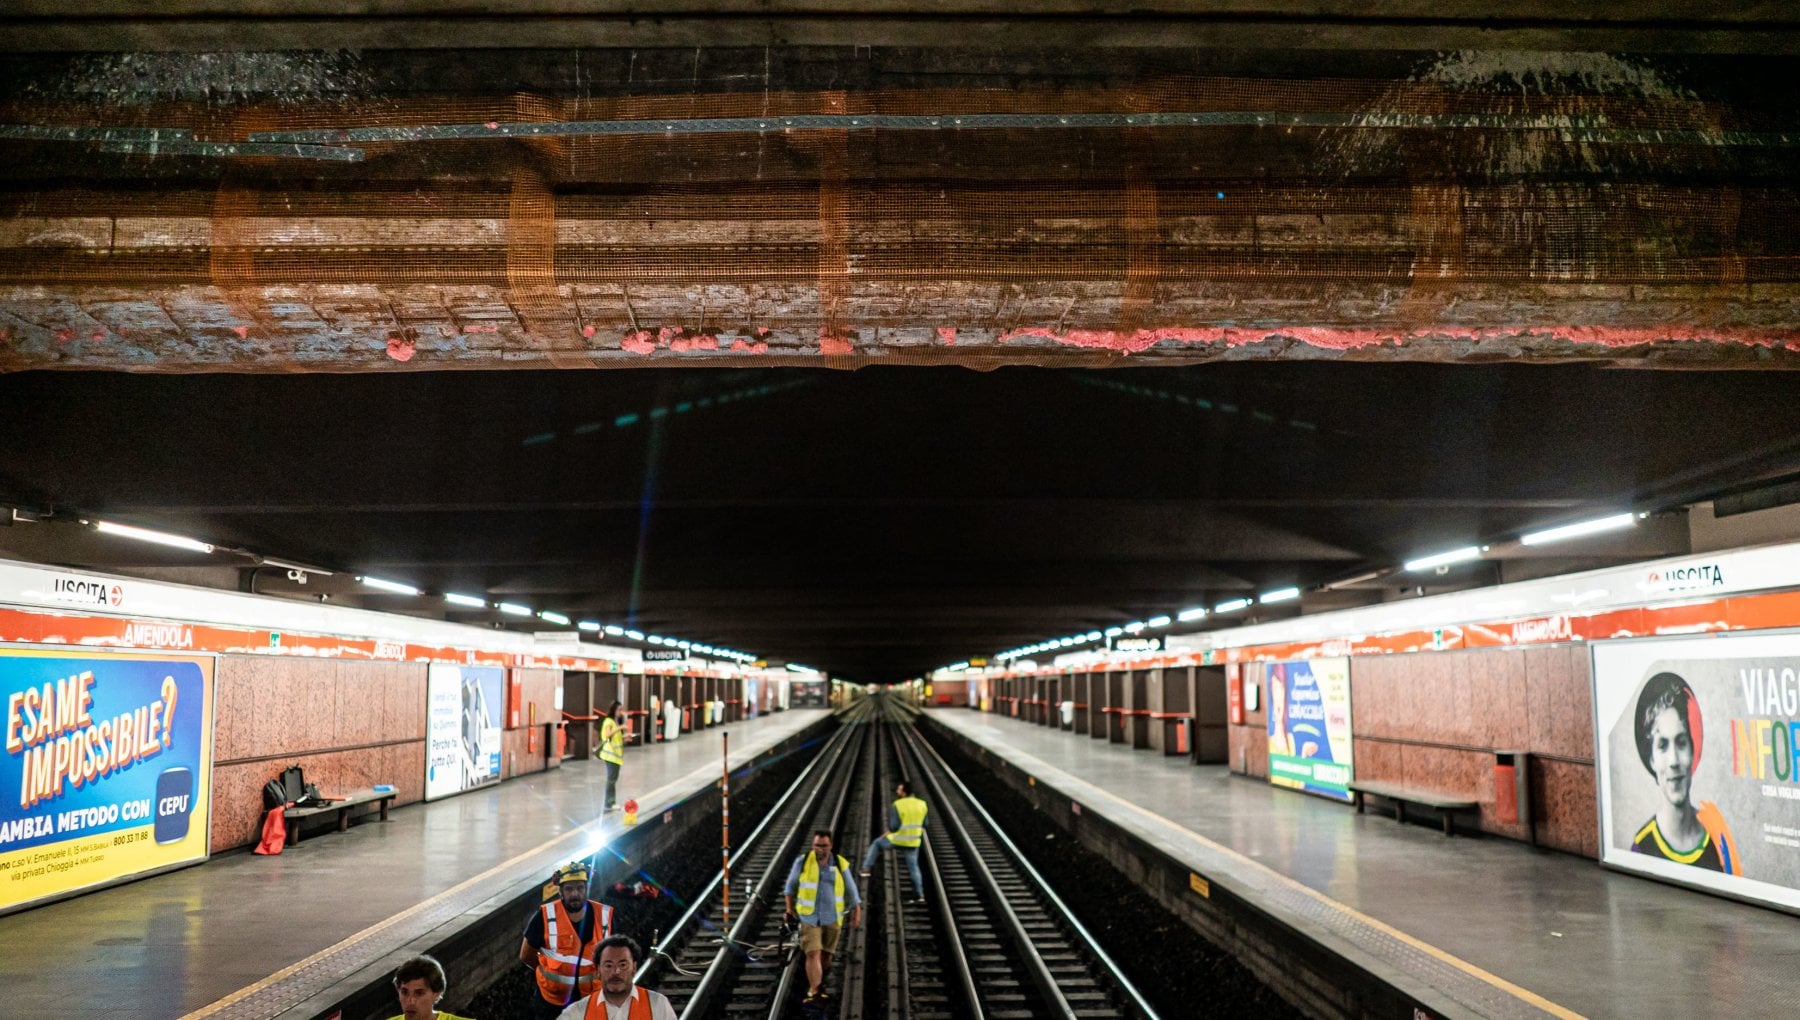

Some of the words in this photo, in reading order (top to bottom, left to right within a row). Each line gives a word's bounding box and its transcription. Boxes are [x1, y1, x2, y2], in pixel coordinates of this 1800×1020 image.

[54, 578, 108, 605] USCITA
[1665, 564, 1724, 592] USCITA
[123, 623, 193, 648] AMENDOLA
[1740, 667, 1800, 717] VIAG
[6, 671, 95, 754] ESAME
[20, 675, 178, 811] IMPOSSIBILE?
[57, 804, 119, 834] METODO
[121, 799, 150, 822] CON
[159, 795, 189, 817] CEPU
[34, 849, 67, 864] Emanuele
[113, 836, 126, 846] 800
[127, 833, 134, 844] 33
[140, 831, 149, 841] 88
[22, 866, 45, 882] privata
[46, 860, 74, 873] Chioggia
